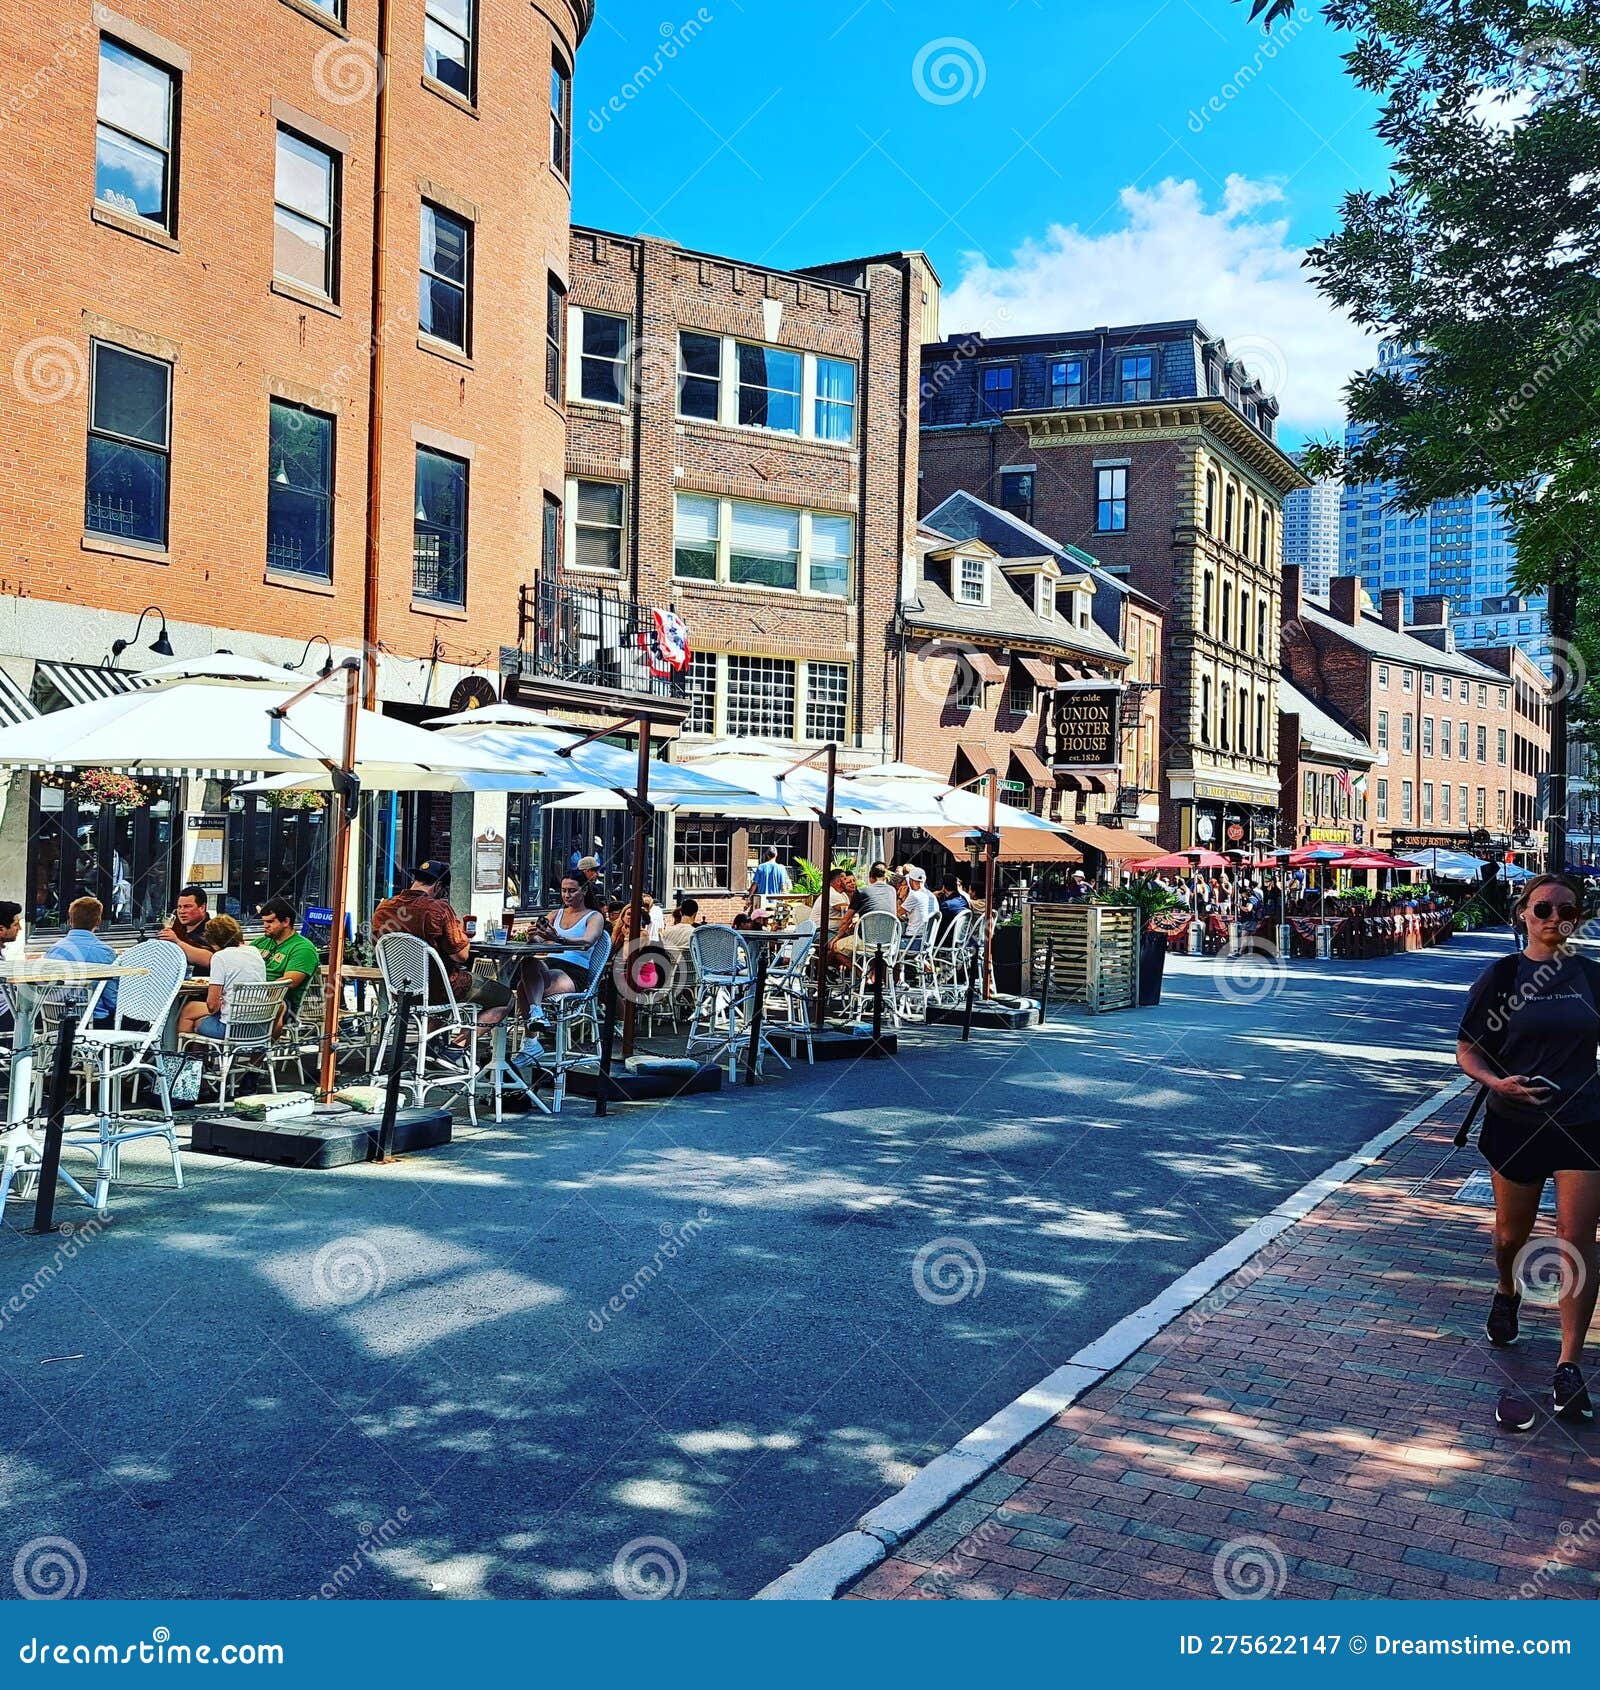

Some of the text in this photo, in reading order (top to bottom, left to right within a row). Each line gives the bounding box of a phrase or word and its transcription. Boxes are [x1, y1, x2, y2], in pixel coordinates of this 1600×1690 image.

[1072, 694, 1101, 704] ye olde
[1062, 706, 1109, 721] UNION
[1059, 722, 1112, 736] OYSTER
[1063, 737, 1107, 751] HOUSE
[1428, 837, 1450, 846] BOSTON
